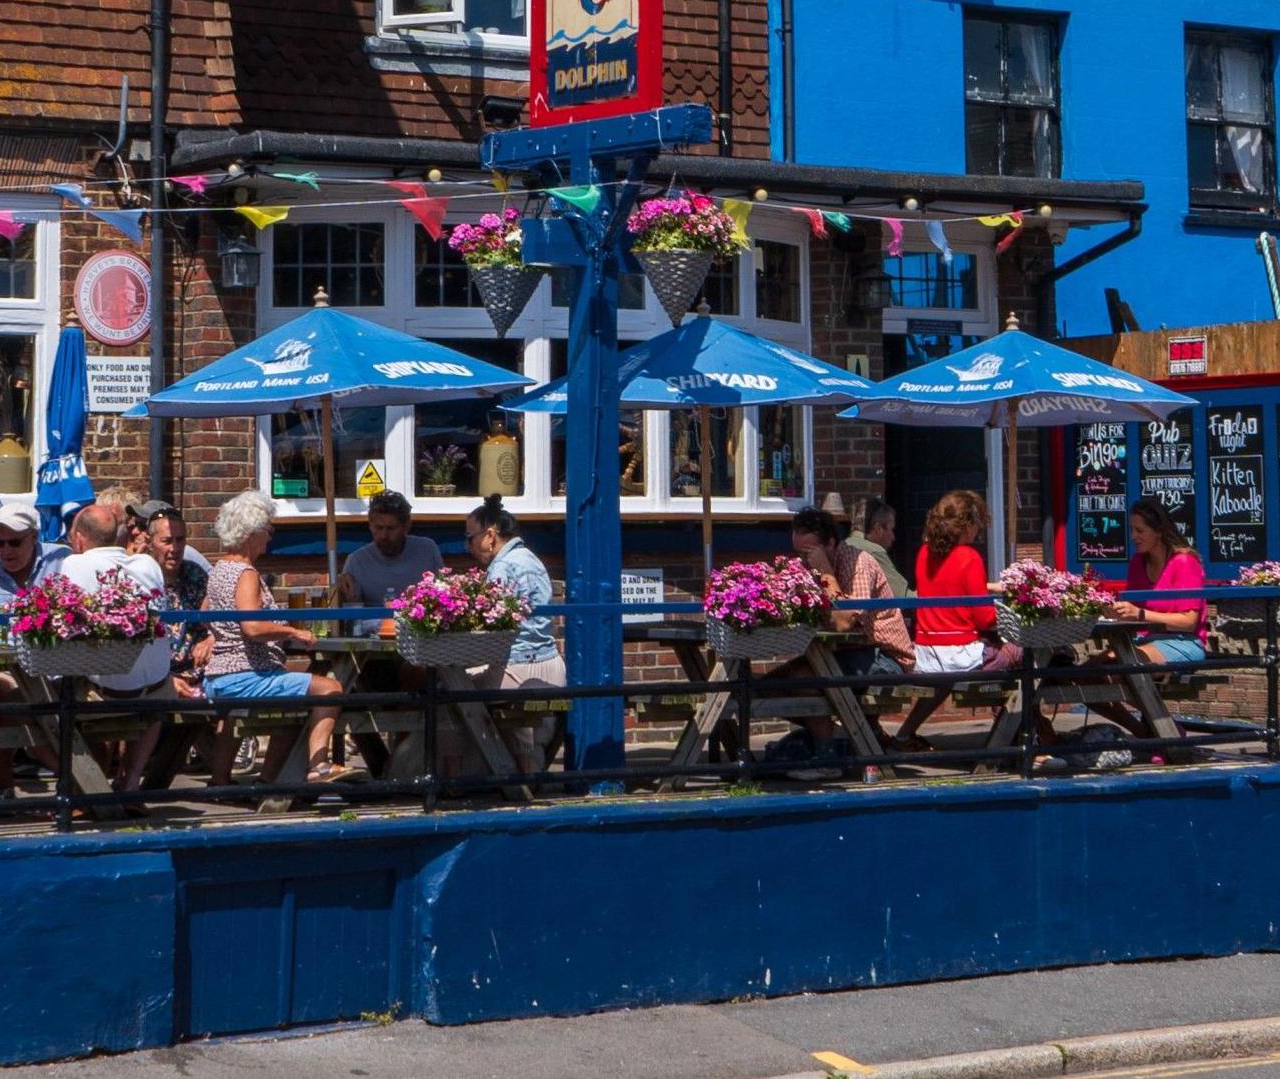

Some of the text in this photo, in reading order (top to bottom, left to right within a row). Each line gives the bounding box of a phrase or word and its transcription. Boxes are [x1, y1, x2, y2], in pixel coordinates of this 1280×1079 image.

[554, 59, 628, 92] DOLPHIN
[106, 364, 124, 372] FOOD
[126, 364, 140, 372] AND
[372, 360, 475, 379] SHIPYARD
[91, 375, 132, 383] PURCHASED
[134, 375, 143, 383] ON
[93, 385, 129, 393] PREMISES
[130, 385, 145, 393] MAY
[193, 372, 329, 393] PORTLAND MAINE USA
[666, 371, 778, 393] SHIPYARD
[898, 379, 1013, 393] PORTLAND MAINE USA
[1051, 372, 1145, 393] SHIPYARD
[96, 396, 134, 404] CONSUMED
[1148, 421, 1180, 443] Pub
[1077, 442, 1119, 469] Bingo
[1142, 443, 1193, 471] QUIZ
[1211, 461, 1256, 486] Kitten
